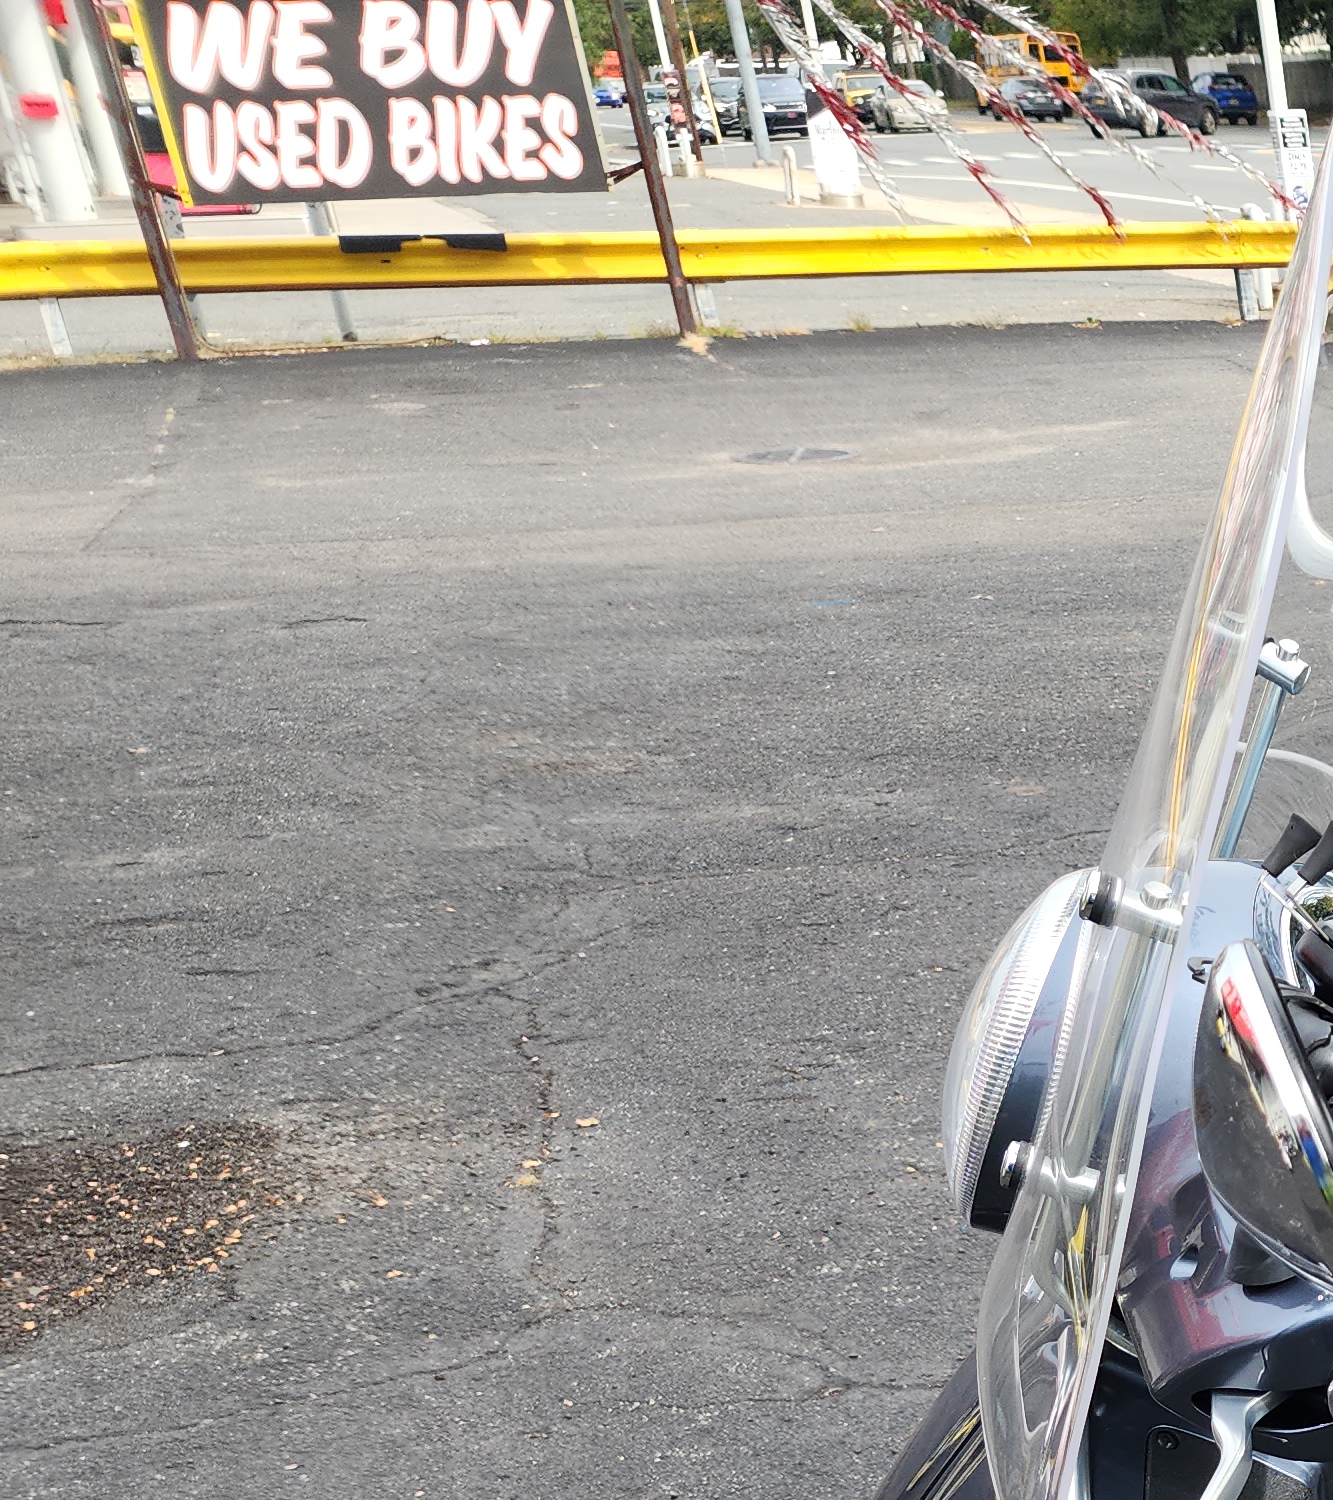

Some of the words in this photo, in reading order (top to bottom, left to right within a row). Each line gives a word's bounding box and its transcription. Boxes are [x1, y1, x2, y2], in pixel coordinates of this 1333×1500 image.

[166, 0, 333, 93] WE
[360, 0, 554, 89] BUY
[183, 99, 374, 193] USED
[388, 93, 585, 186] BIKES
